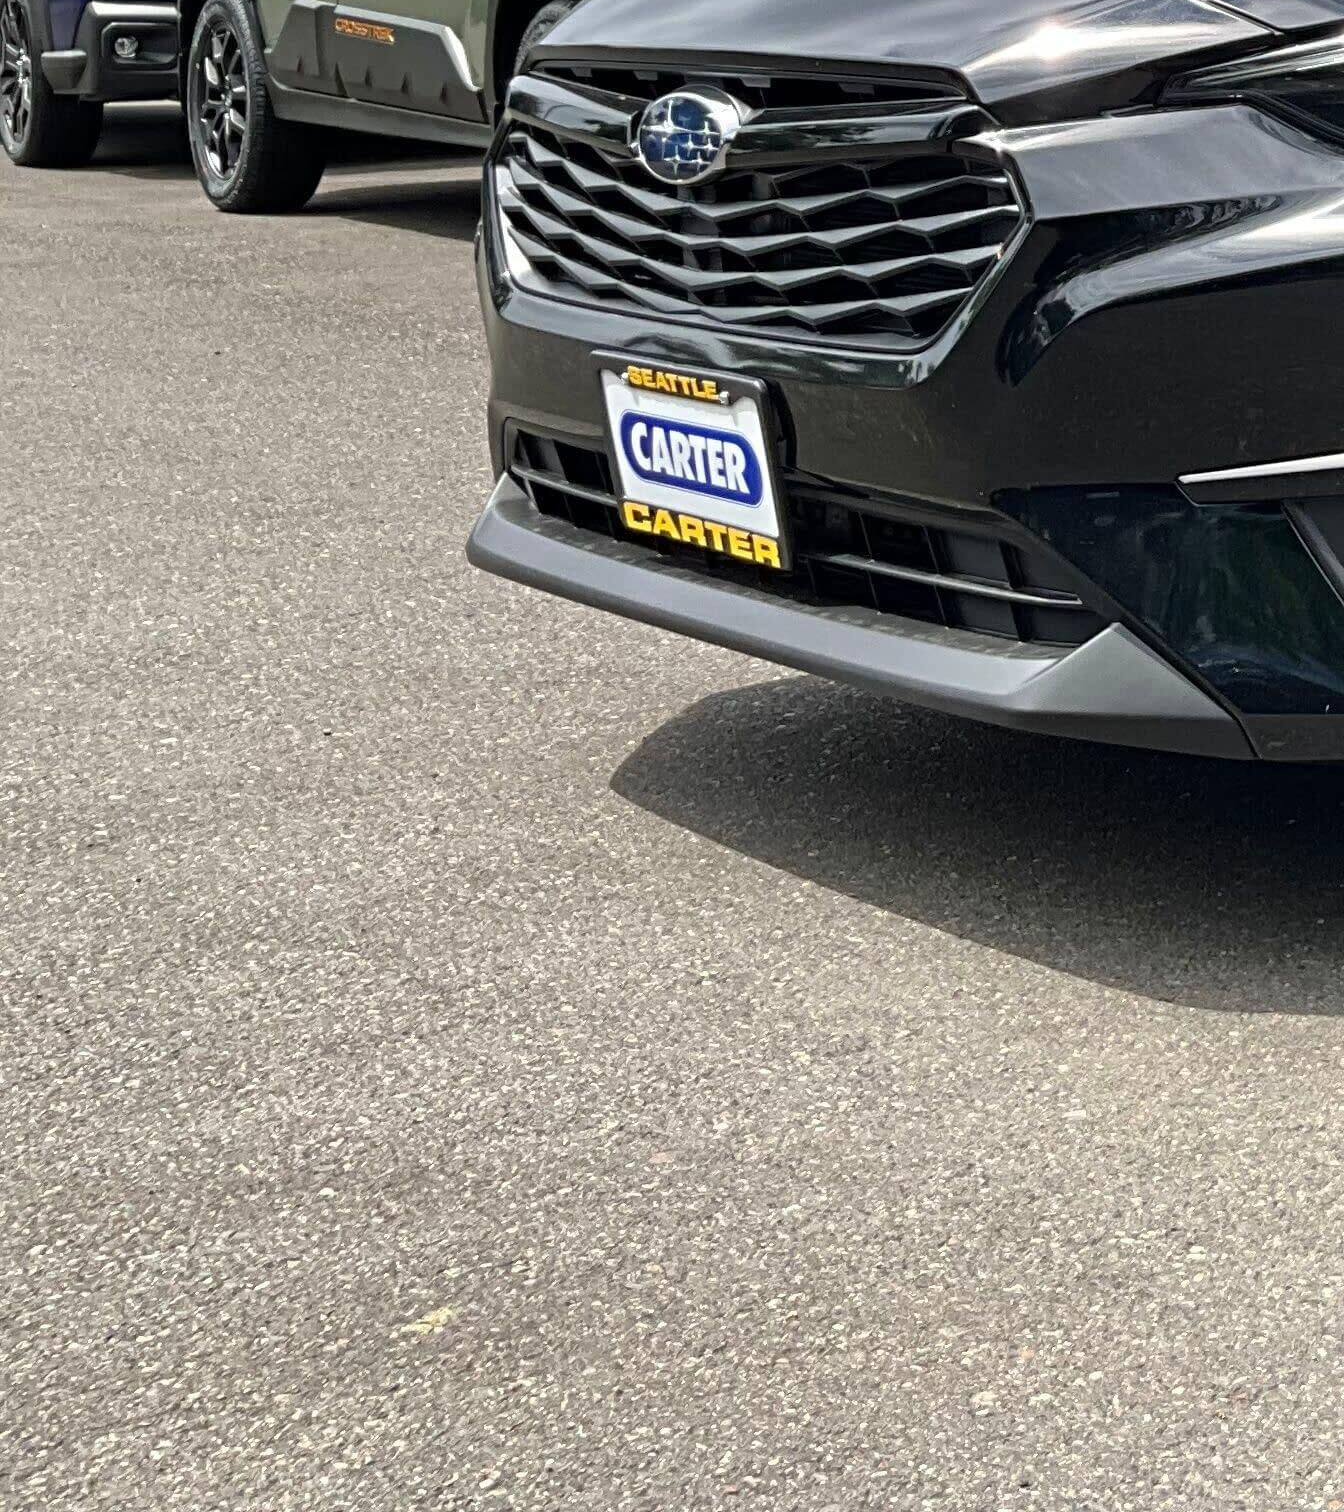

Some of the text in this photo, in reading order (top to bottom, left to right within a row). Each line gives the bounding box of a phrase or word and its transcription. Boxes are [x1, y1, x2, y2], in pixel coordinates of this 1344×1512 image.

[335, 18, 395, 44] CROSSTREK
[627, 365, 720, 400] SEATTLE
[631, 422, 750, 494] CARTER
[623, 501, 782, 569] CARTER
